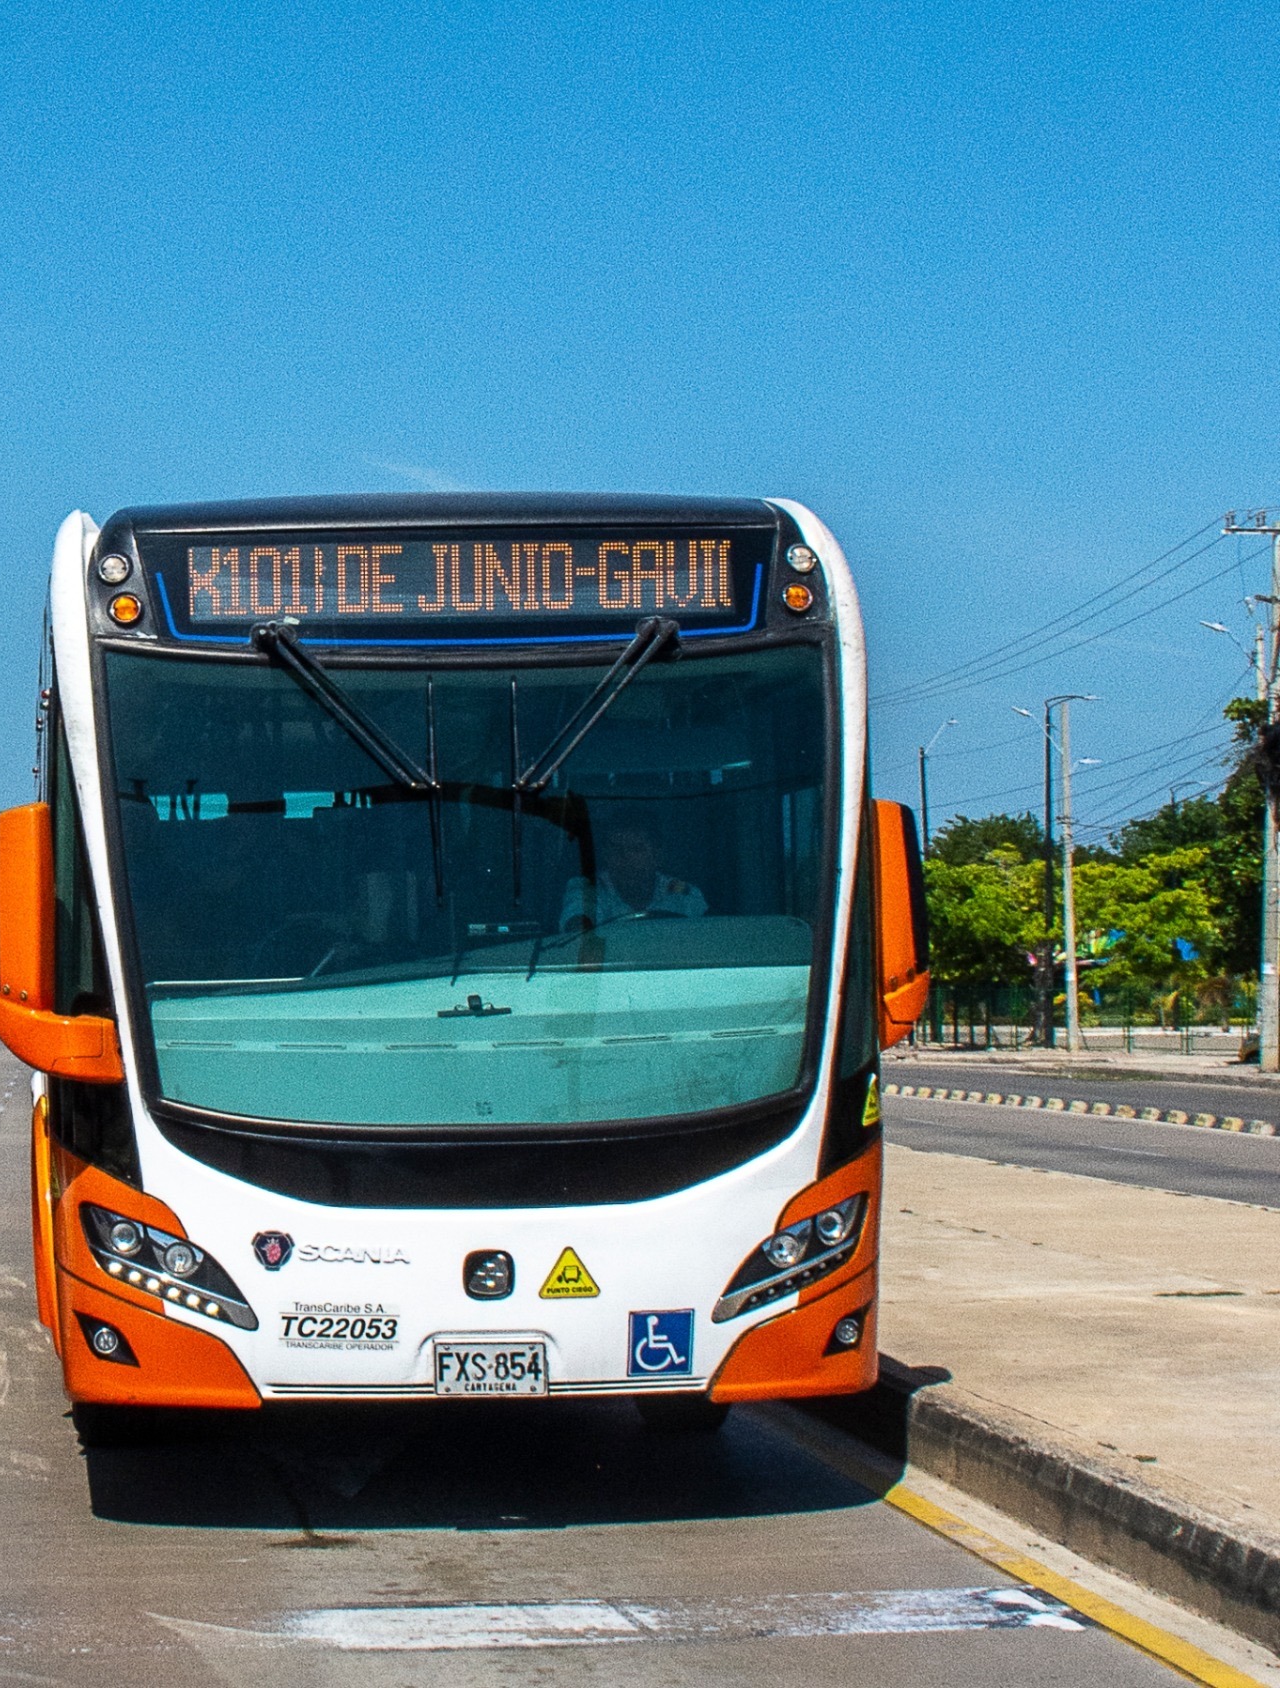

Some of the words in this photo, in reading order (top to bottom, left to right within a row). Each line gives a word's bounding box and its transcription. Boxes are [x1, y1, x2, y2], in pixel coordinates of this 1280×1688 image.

[337, 545, 403, 614] DE
[298, 1244, 410, 1264] SCANIA
[294, 1302, 361, 1314] TransCaribe
[364, 1303, 388, 1314] S.A.
[280, 1315, 398, 1340] TC22053
[286, 1340, 344, 1351] TRANSCARIBE
[345, 1342, 395, 1352] OPERADOR
[464, 1382, 517, 1391] CARTAGENA
